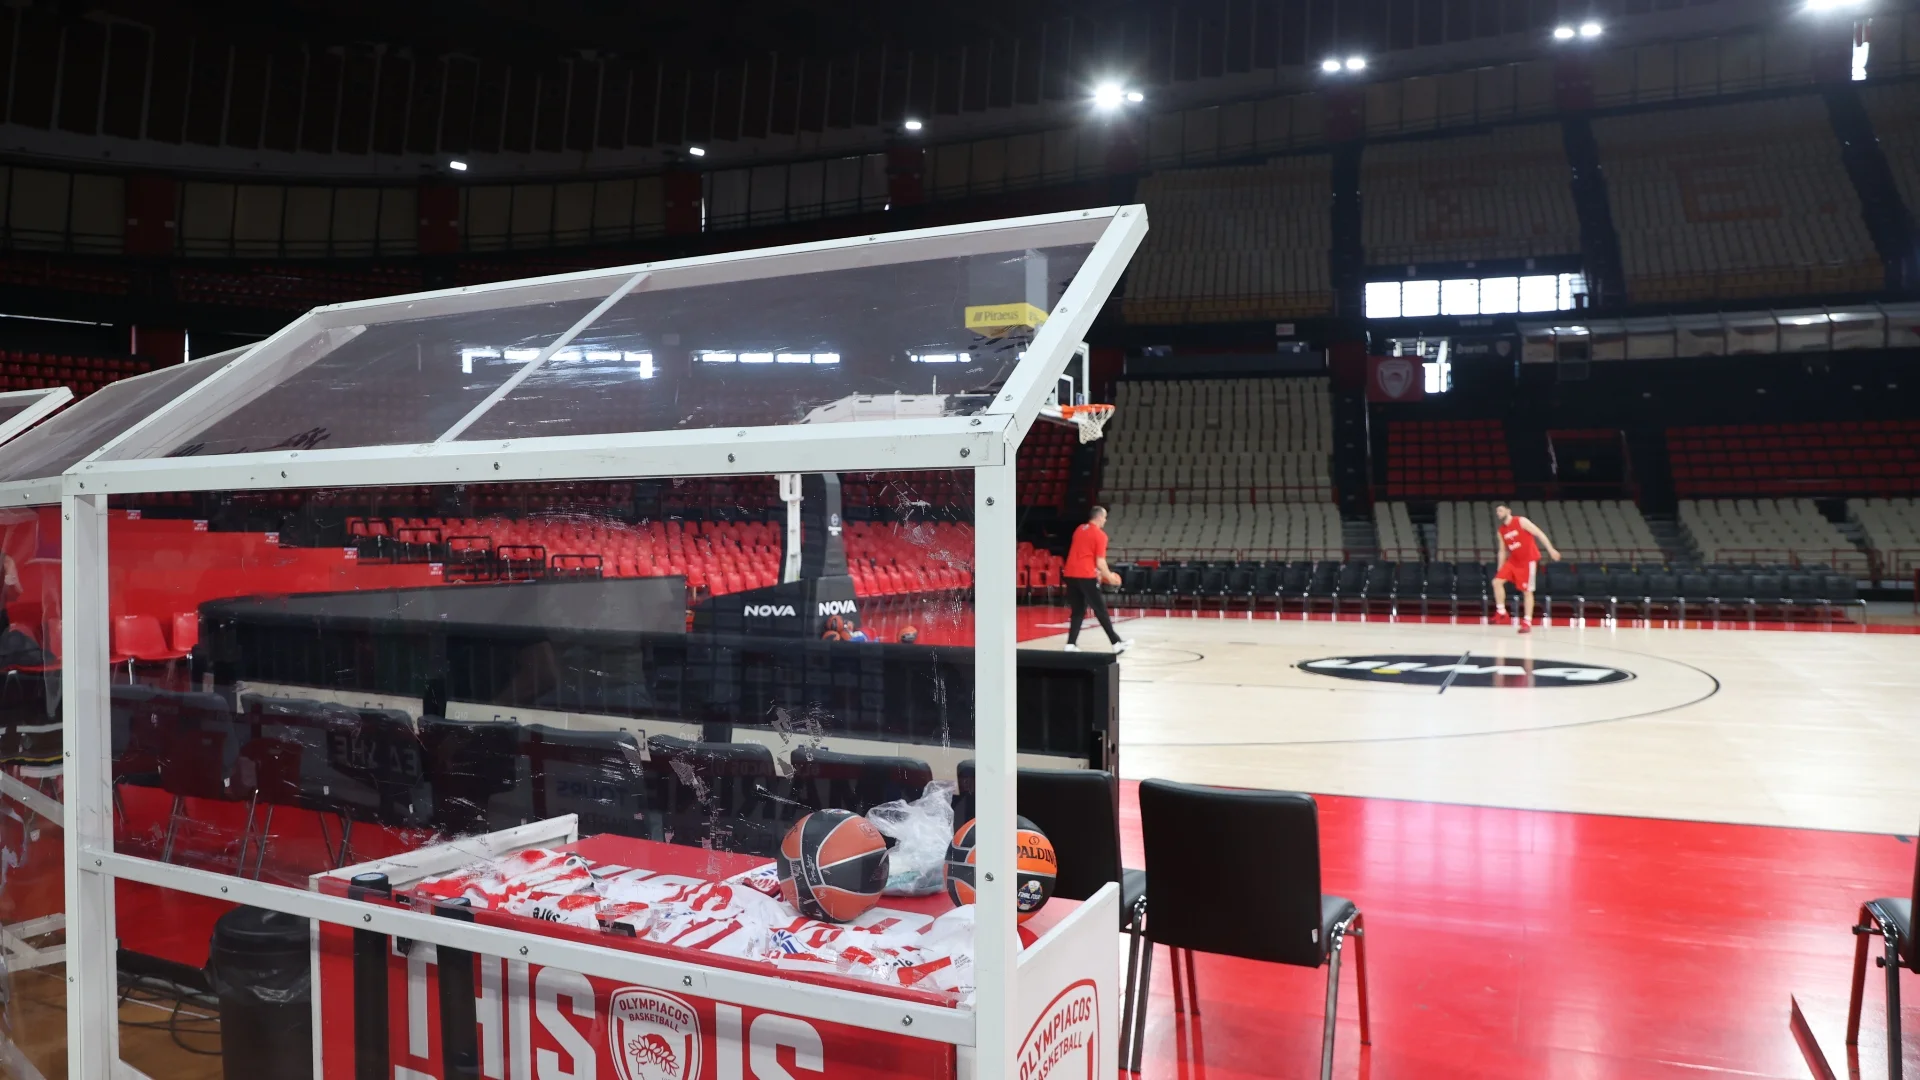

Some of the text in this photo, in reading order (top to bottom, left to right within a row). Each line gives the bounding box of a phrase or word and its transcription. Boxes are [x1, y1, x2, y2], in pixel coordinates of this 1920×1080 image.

[984, 310, 1019, 321] Piraeus
[743, 605, 796, 617] NOVA
[818, 599, 857, 617] NOVA
[619, 997, 690, 1025] OLYMPIACOS
[628, 1012, 680, 1034] BASKETBALL
[1019, 996, 1092, 1080] OLYMPIACOS
[1033, 1030, 1083, 1080] ASKETBALL
